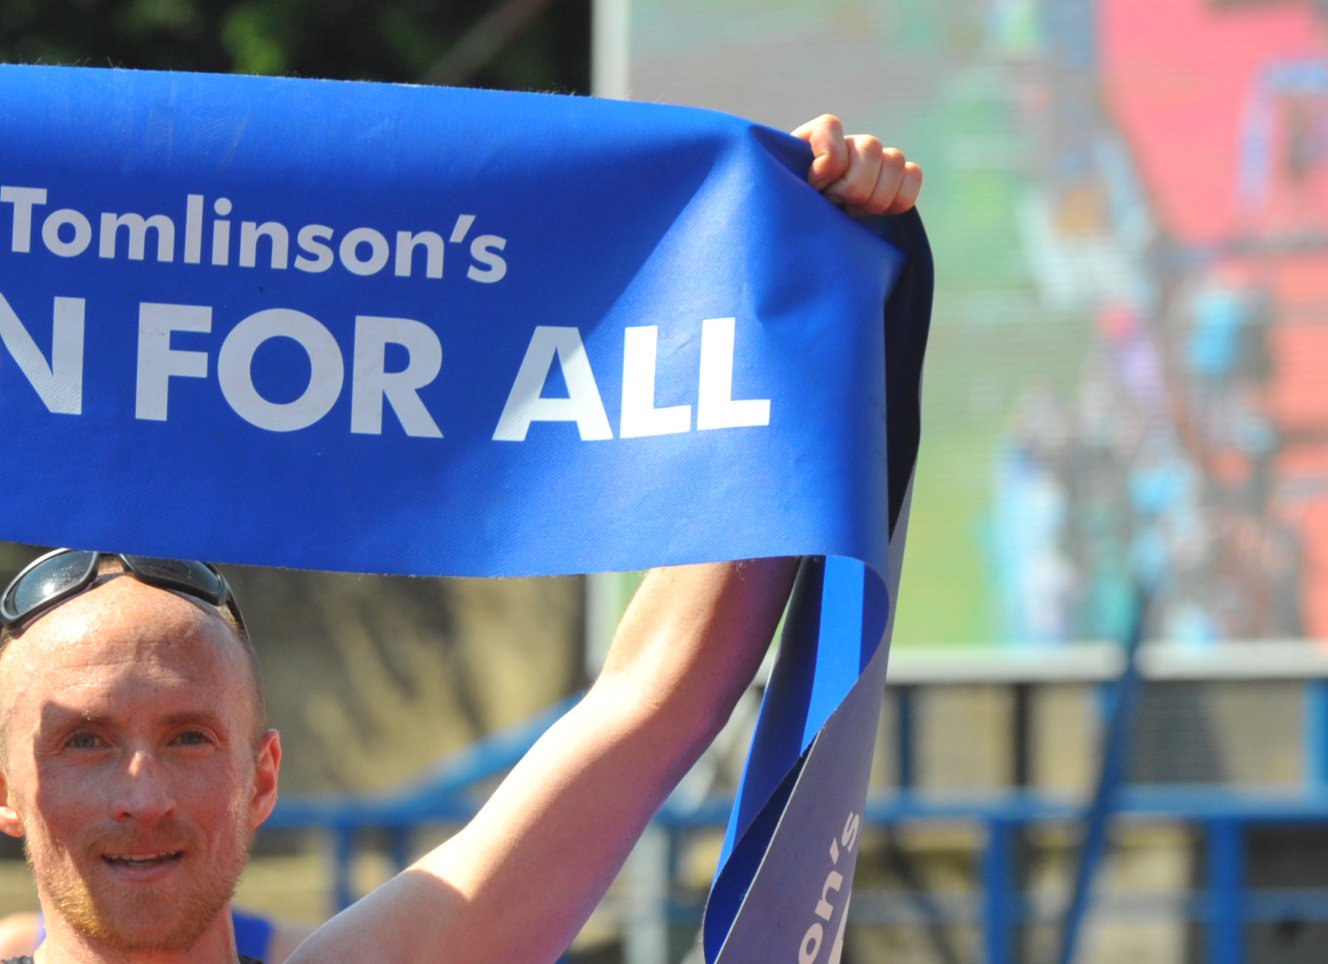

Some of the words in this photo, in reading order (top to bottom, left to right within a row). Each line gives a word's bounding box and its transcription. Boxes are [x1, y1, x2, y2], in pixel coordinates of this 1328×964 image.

[0, 185, 508, 283] Tomlinson's
[135, 302, 444, 439] FOR
[491, 317, 771, 442] ALL
